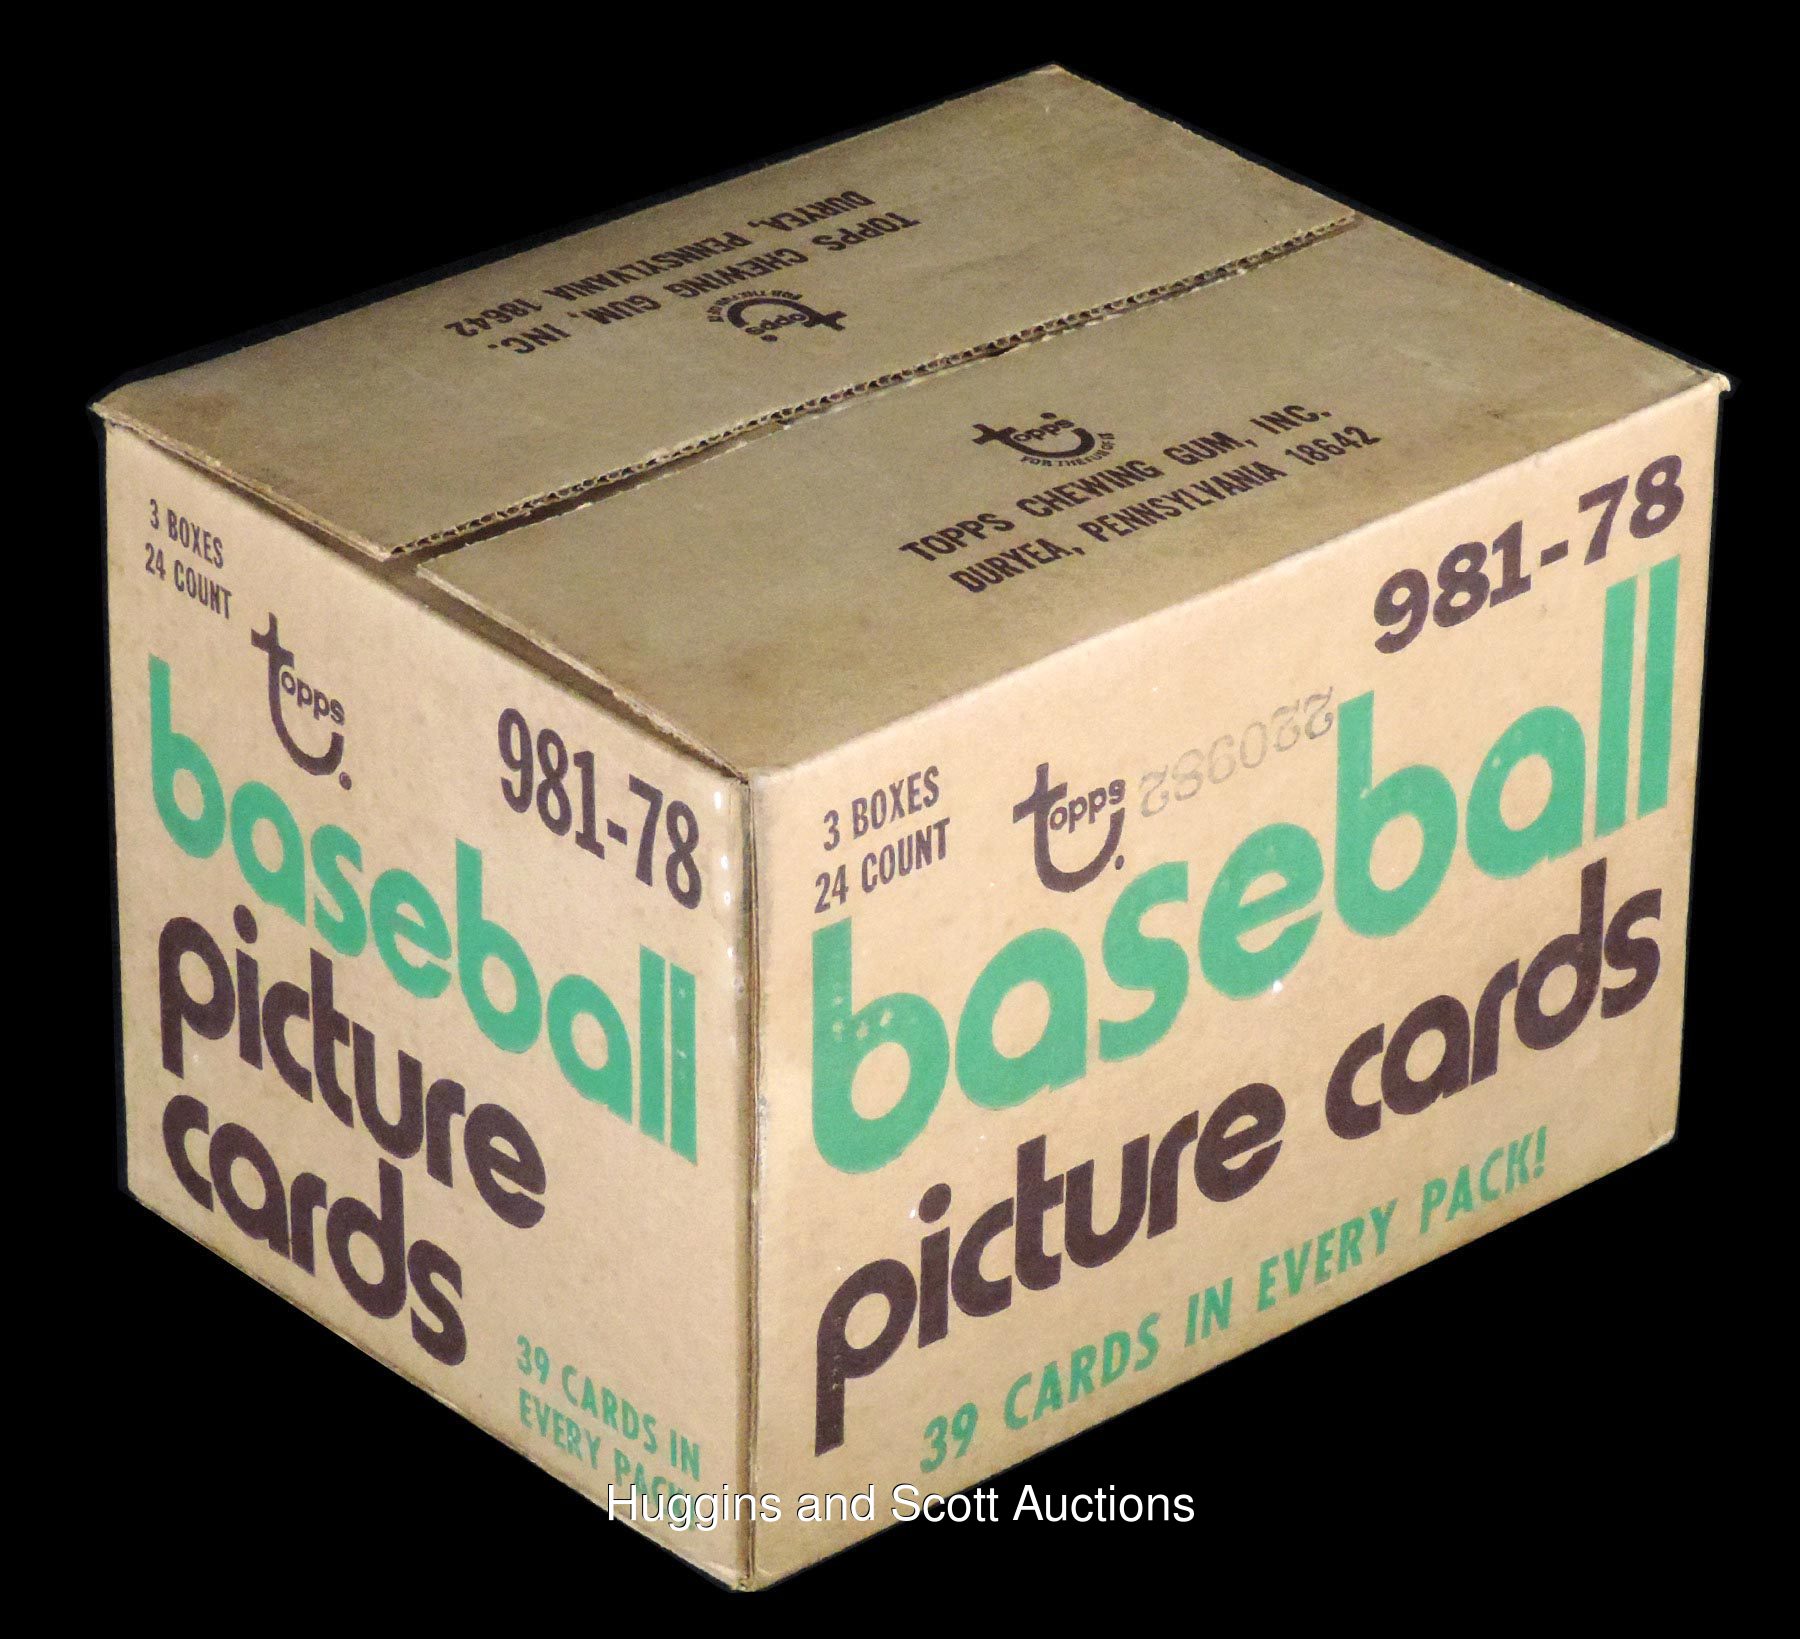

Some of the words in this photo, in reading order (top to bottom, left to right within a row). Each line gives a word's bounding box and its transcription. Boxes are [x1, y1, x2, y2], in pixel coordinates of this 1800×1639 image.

[748, 190, 875, 232] DURYEA,
[812, 212, 921, 251] TOPPS
[544, 231, 752, 301] PENNSYLVANIA
[568, 294, 662, 325] GUM,
[663, 247, 809, 298] CHEWING
[444, 298, 543, 337] 18642
[488, 323, 570, 354] INC.
[900, 512, 1015, 562] TOPPS
[1015, 459, 1164, 519] CHEWING
[1163, 430, 1255, 467] GUM,
[1252, 404, 1332, 435] INC.
[949, 537, 1083, 593] DURYEA,
[1078, 460, 1288, 544] PENNSYLVANIA
[1285, 425, 1381, 466] 18642
[145, 542, 167, 581] 24
[173, 560, 232, 620] COUNT
[149, 498, 160, 530] 3
[167, 508, 225, 569] BOXES
[1373, 454, 1685, 655] 981-78
[498, 708, 702, 910] 981-78
[823, 810, 842, 852] 3
[852, 765, 941, 840] BOXES
[148, 653, 698, 1167] baseball
[810, 554, 1680, 1174] baseball
[813, 864, 850, 914] 24
[861, 818, 950, 893] COUNT
[158, 904, 547, 1230] picture
[814, 1081, 1287, 1457] picture
[1324, 857, 1663, 1140] cards
[162, 1095, 468, 1367] cards
[920, 1402, 980, 1475] 39
[1003, 1311, 1161, 1431] CARDS
[1185, 1277, 1236, 1348] IN
[1256, 1198, 1398, 1315] EVERY
[1419, 1124, 1549, 1235] PACK!
[516, 1334, 550, 1384] 39
[562, 1365, 657, 1453] CARDS
[669, 1428, 701, 1483] IN
[518, 1387, 602, 1465] EVERY
